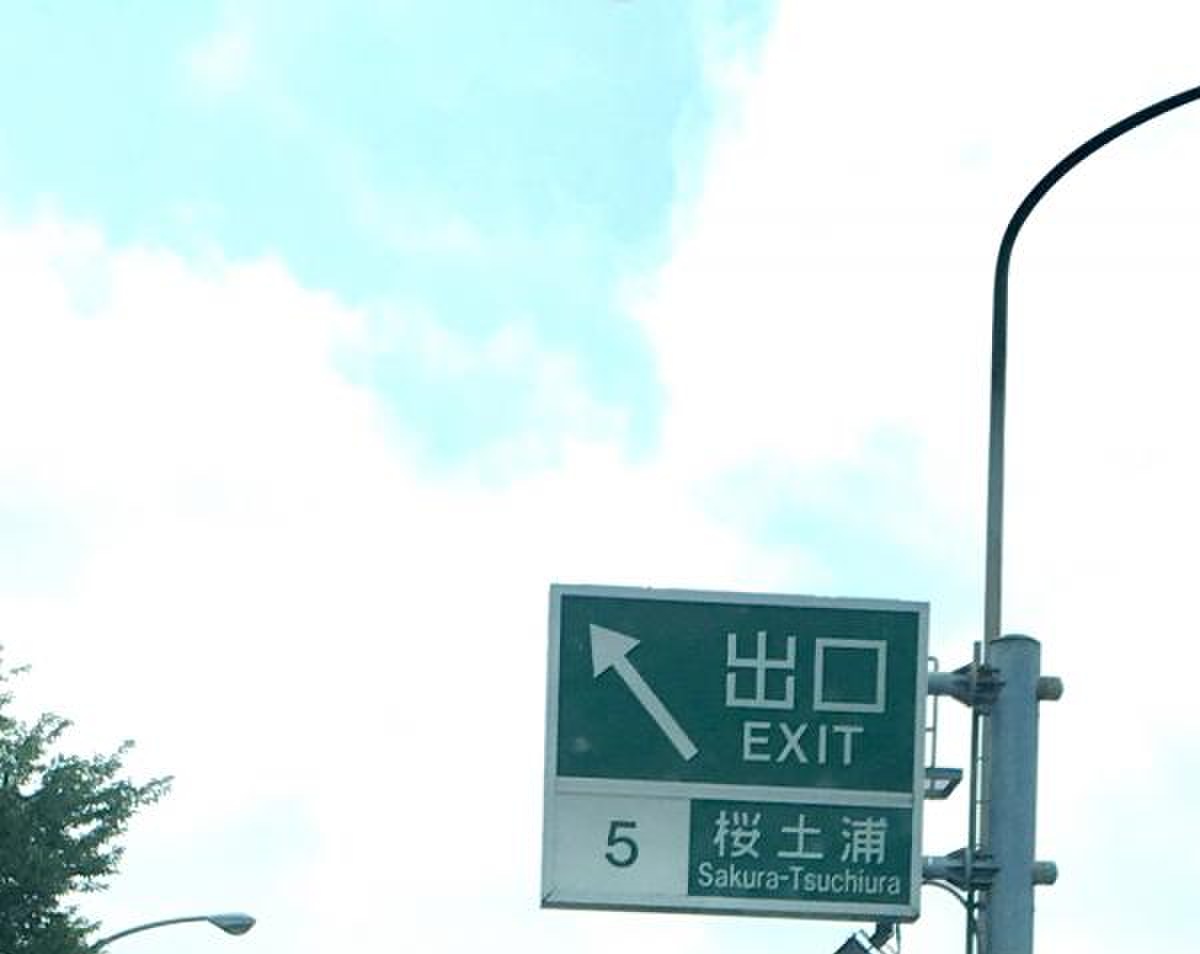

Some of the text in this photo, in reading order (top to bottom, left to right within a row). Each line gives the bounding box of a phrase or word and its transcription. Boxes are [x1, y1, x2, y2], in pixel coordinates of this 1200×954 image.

[725, 630, 888, 713] 出口
[743, 721, 864, 765] EXIT
[604, 820, 640, 867] 5
[714, 809, 889, 864] 桜土浦
[698, 862, 901, 895] Sakura-Tsuchiura
